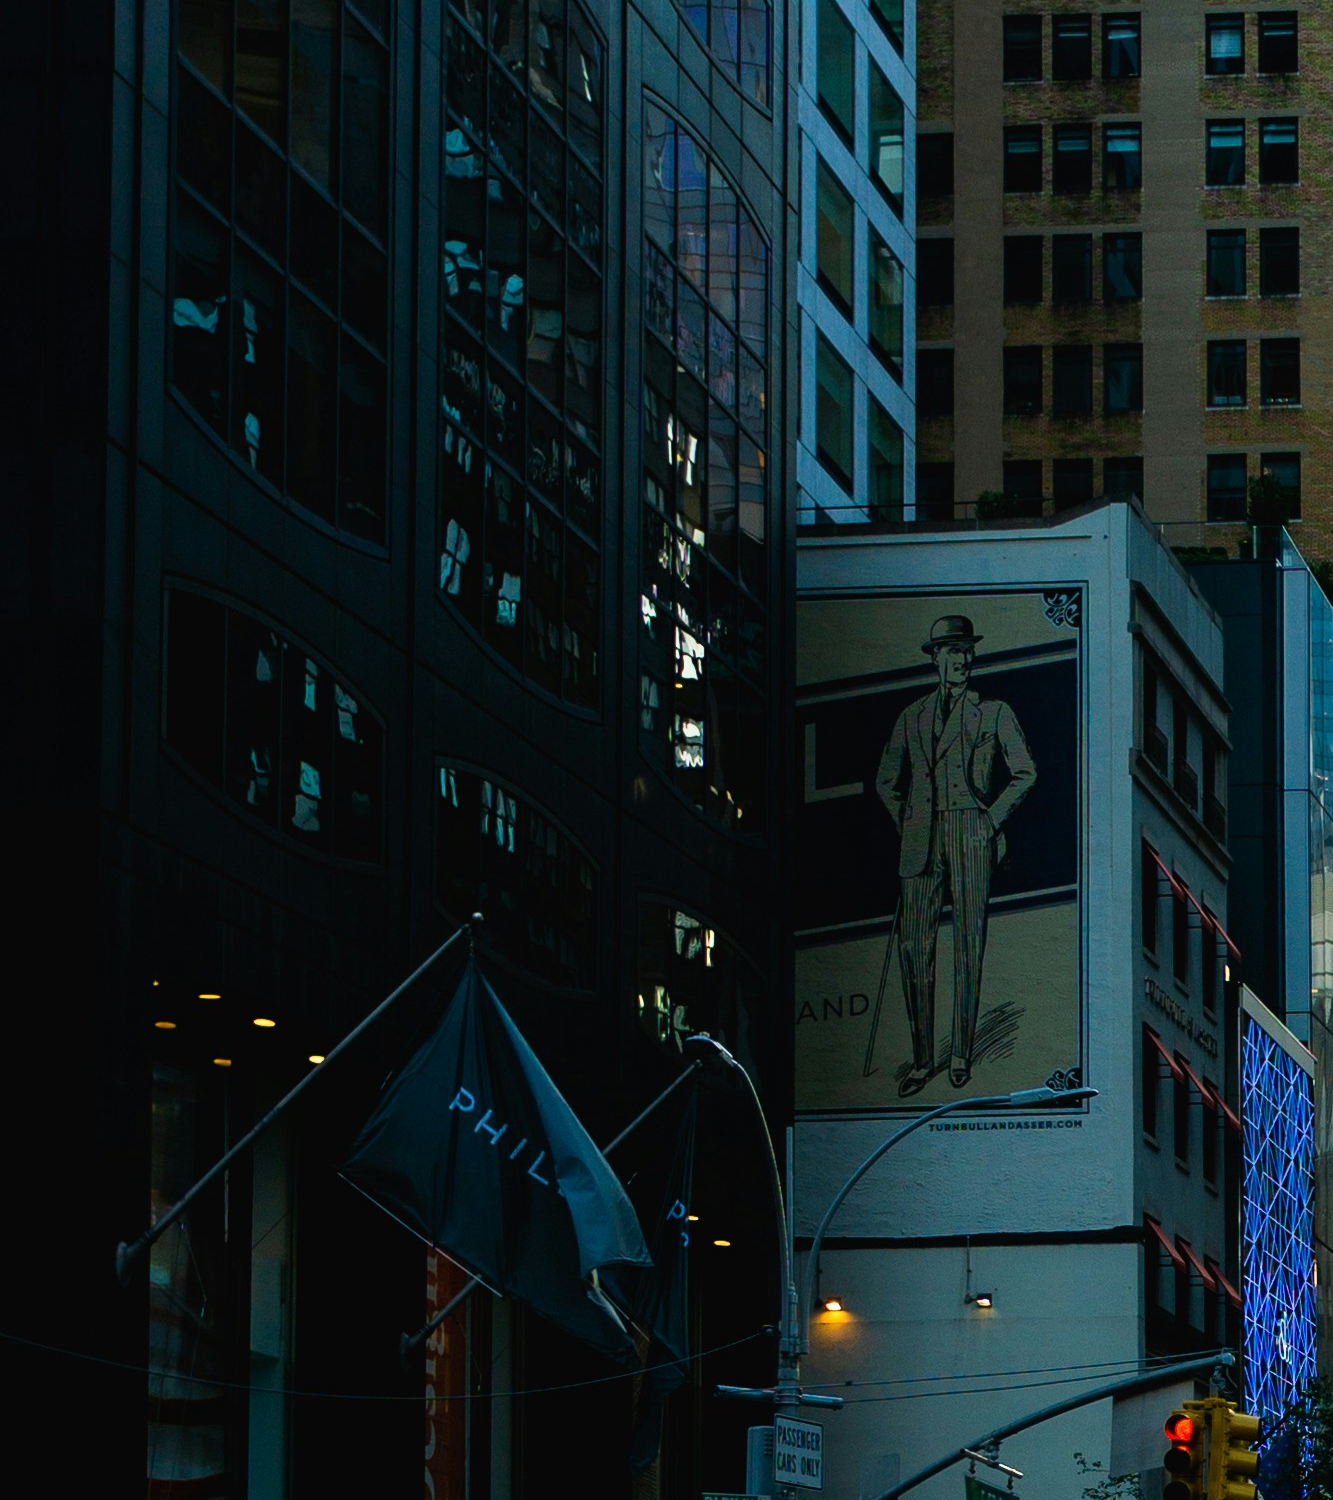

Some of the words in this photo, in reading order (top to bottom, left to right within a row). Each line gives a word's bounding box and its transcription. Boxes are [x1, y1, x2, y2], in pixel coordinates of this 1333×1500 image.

[796, 993, 870, 1024] AND
[928, 1119, 1083, 1133] TURNBULLANDASSER.COM
[448, 1086, 568, 1198] PHIL
[777, 1425, 821, 1451] PASSENGER
[776, 1451, 797, 1473] CARS
[801, 1455, 821, 1478] ONLY
